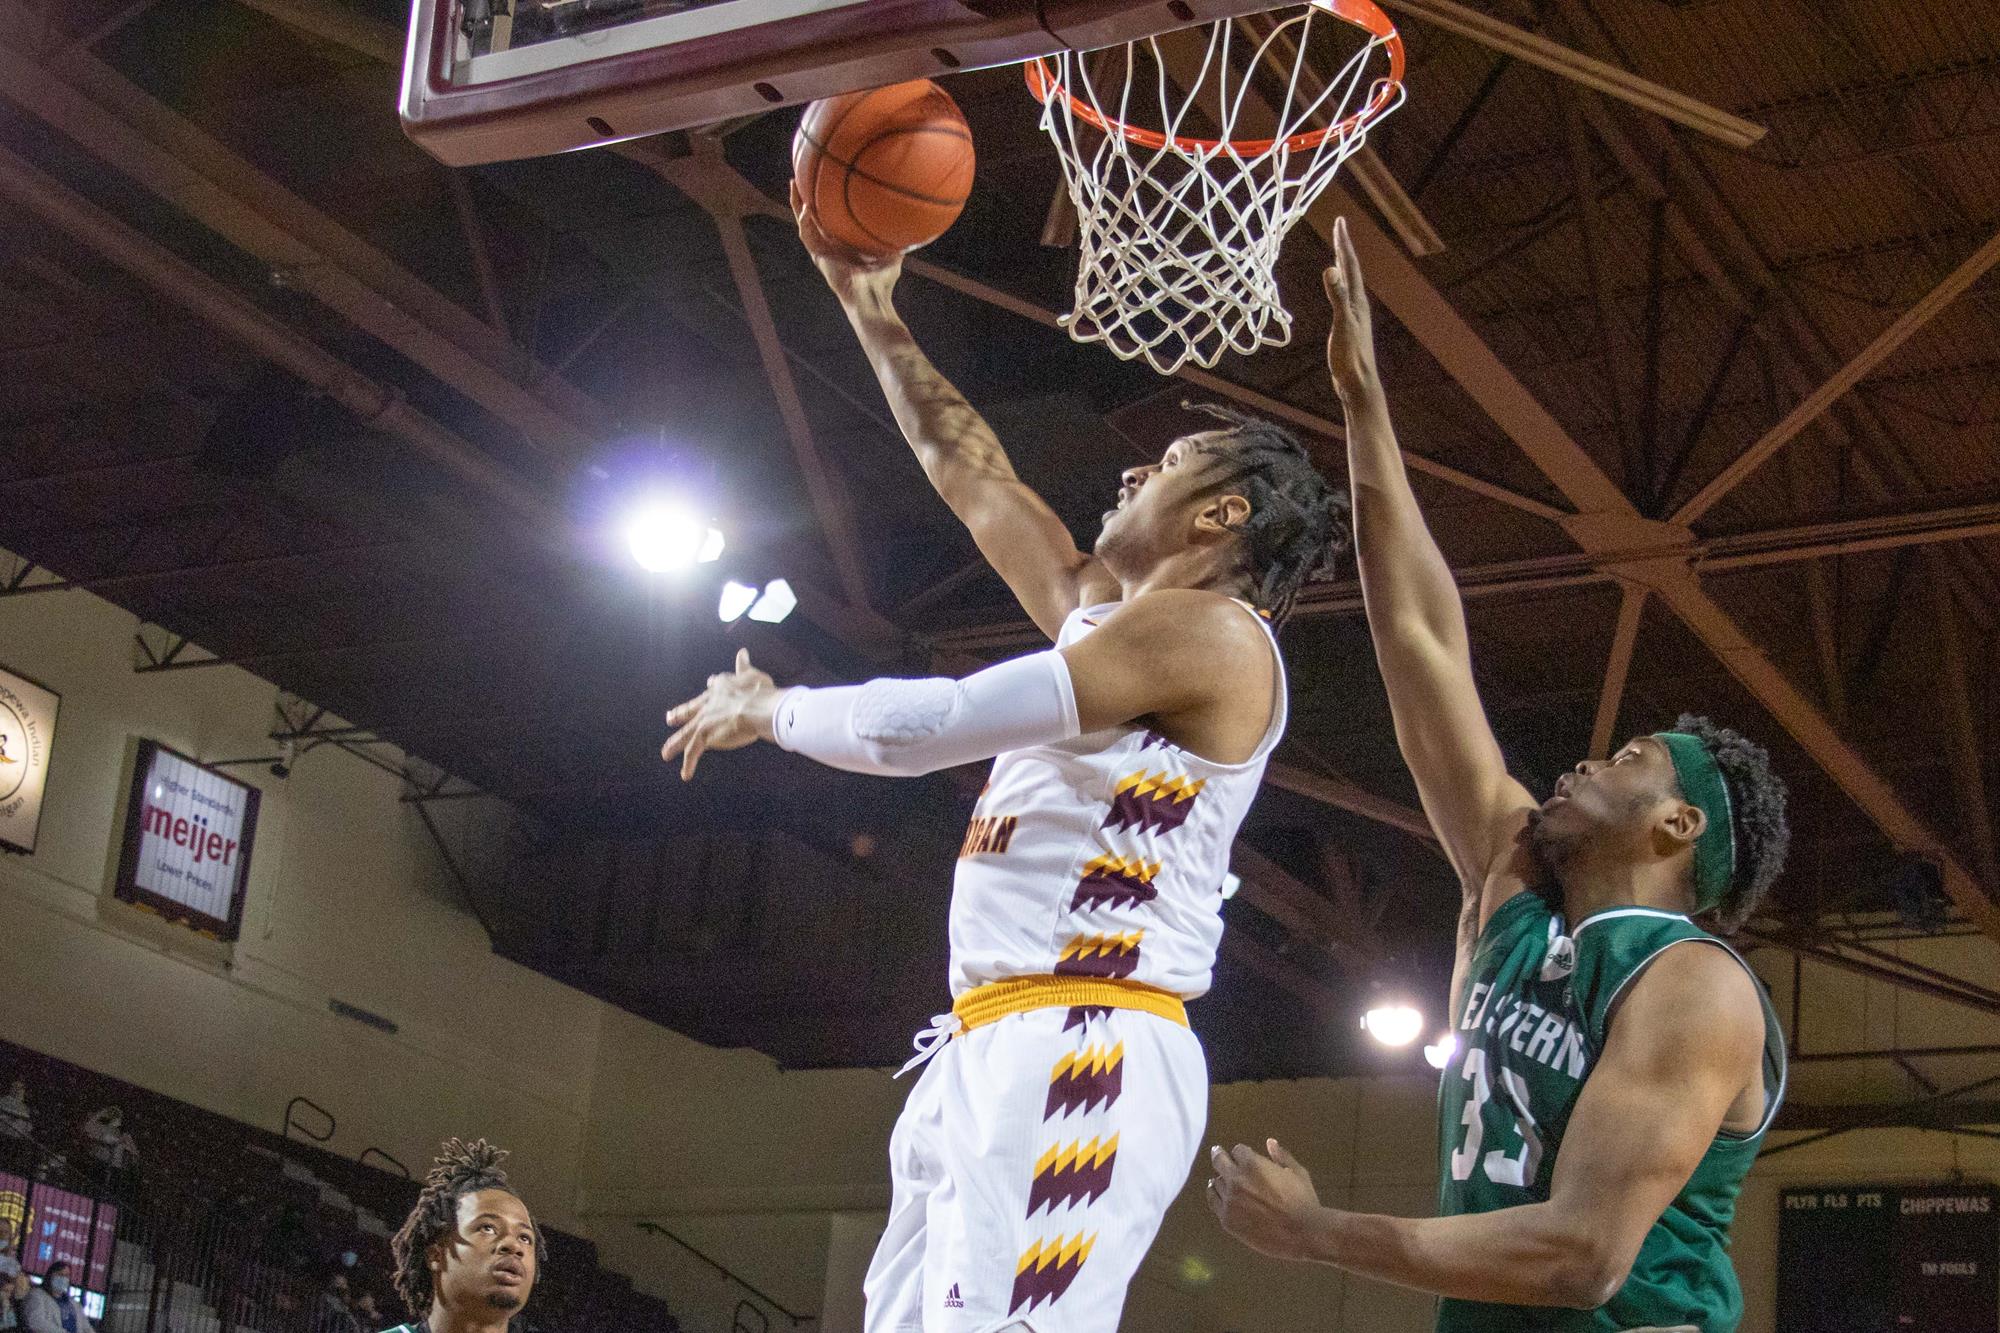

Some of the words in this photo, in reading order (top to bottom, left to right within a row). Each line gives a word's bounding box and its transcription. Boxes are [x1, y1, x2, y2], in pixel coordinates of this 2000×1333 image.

[143, 803, 237, 866] meijer
[1824, 1194, 1848, 1208] FLS
[1857, 1193, 1882, 1208] PTS
[1900, 1197, 1991, 1215] CHIPPEWAS
